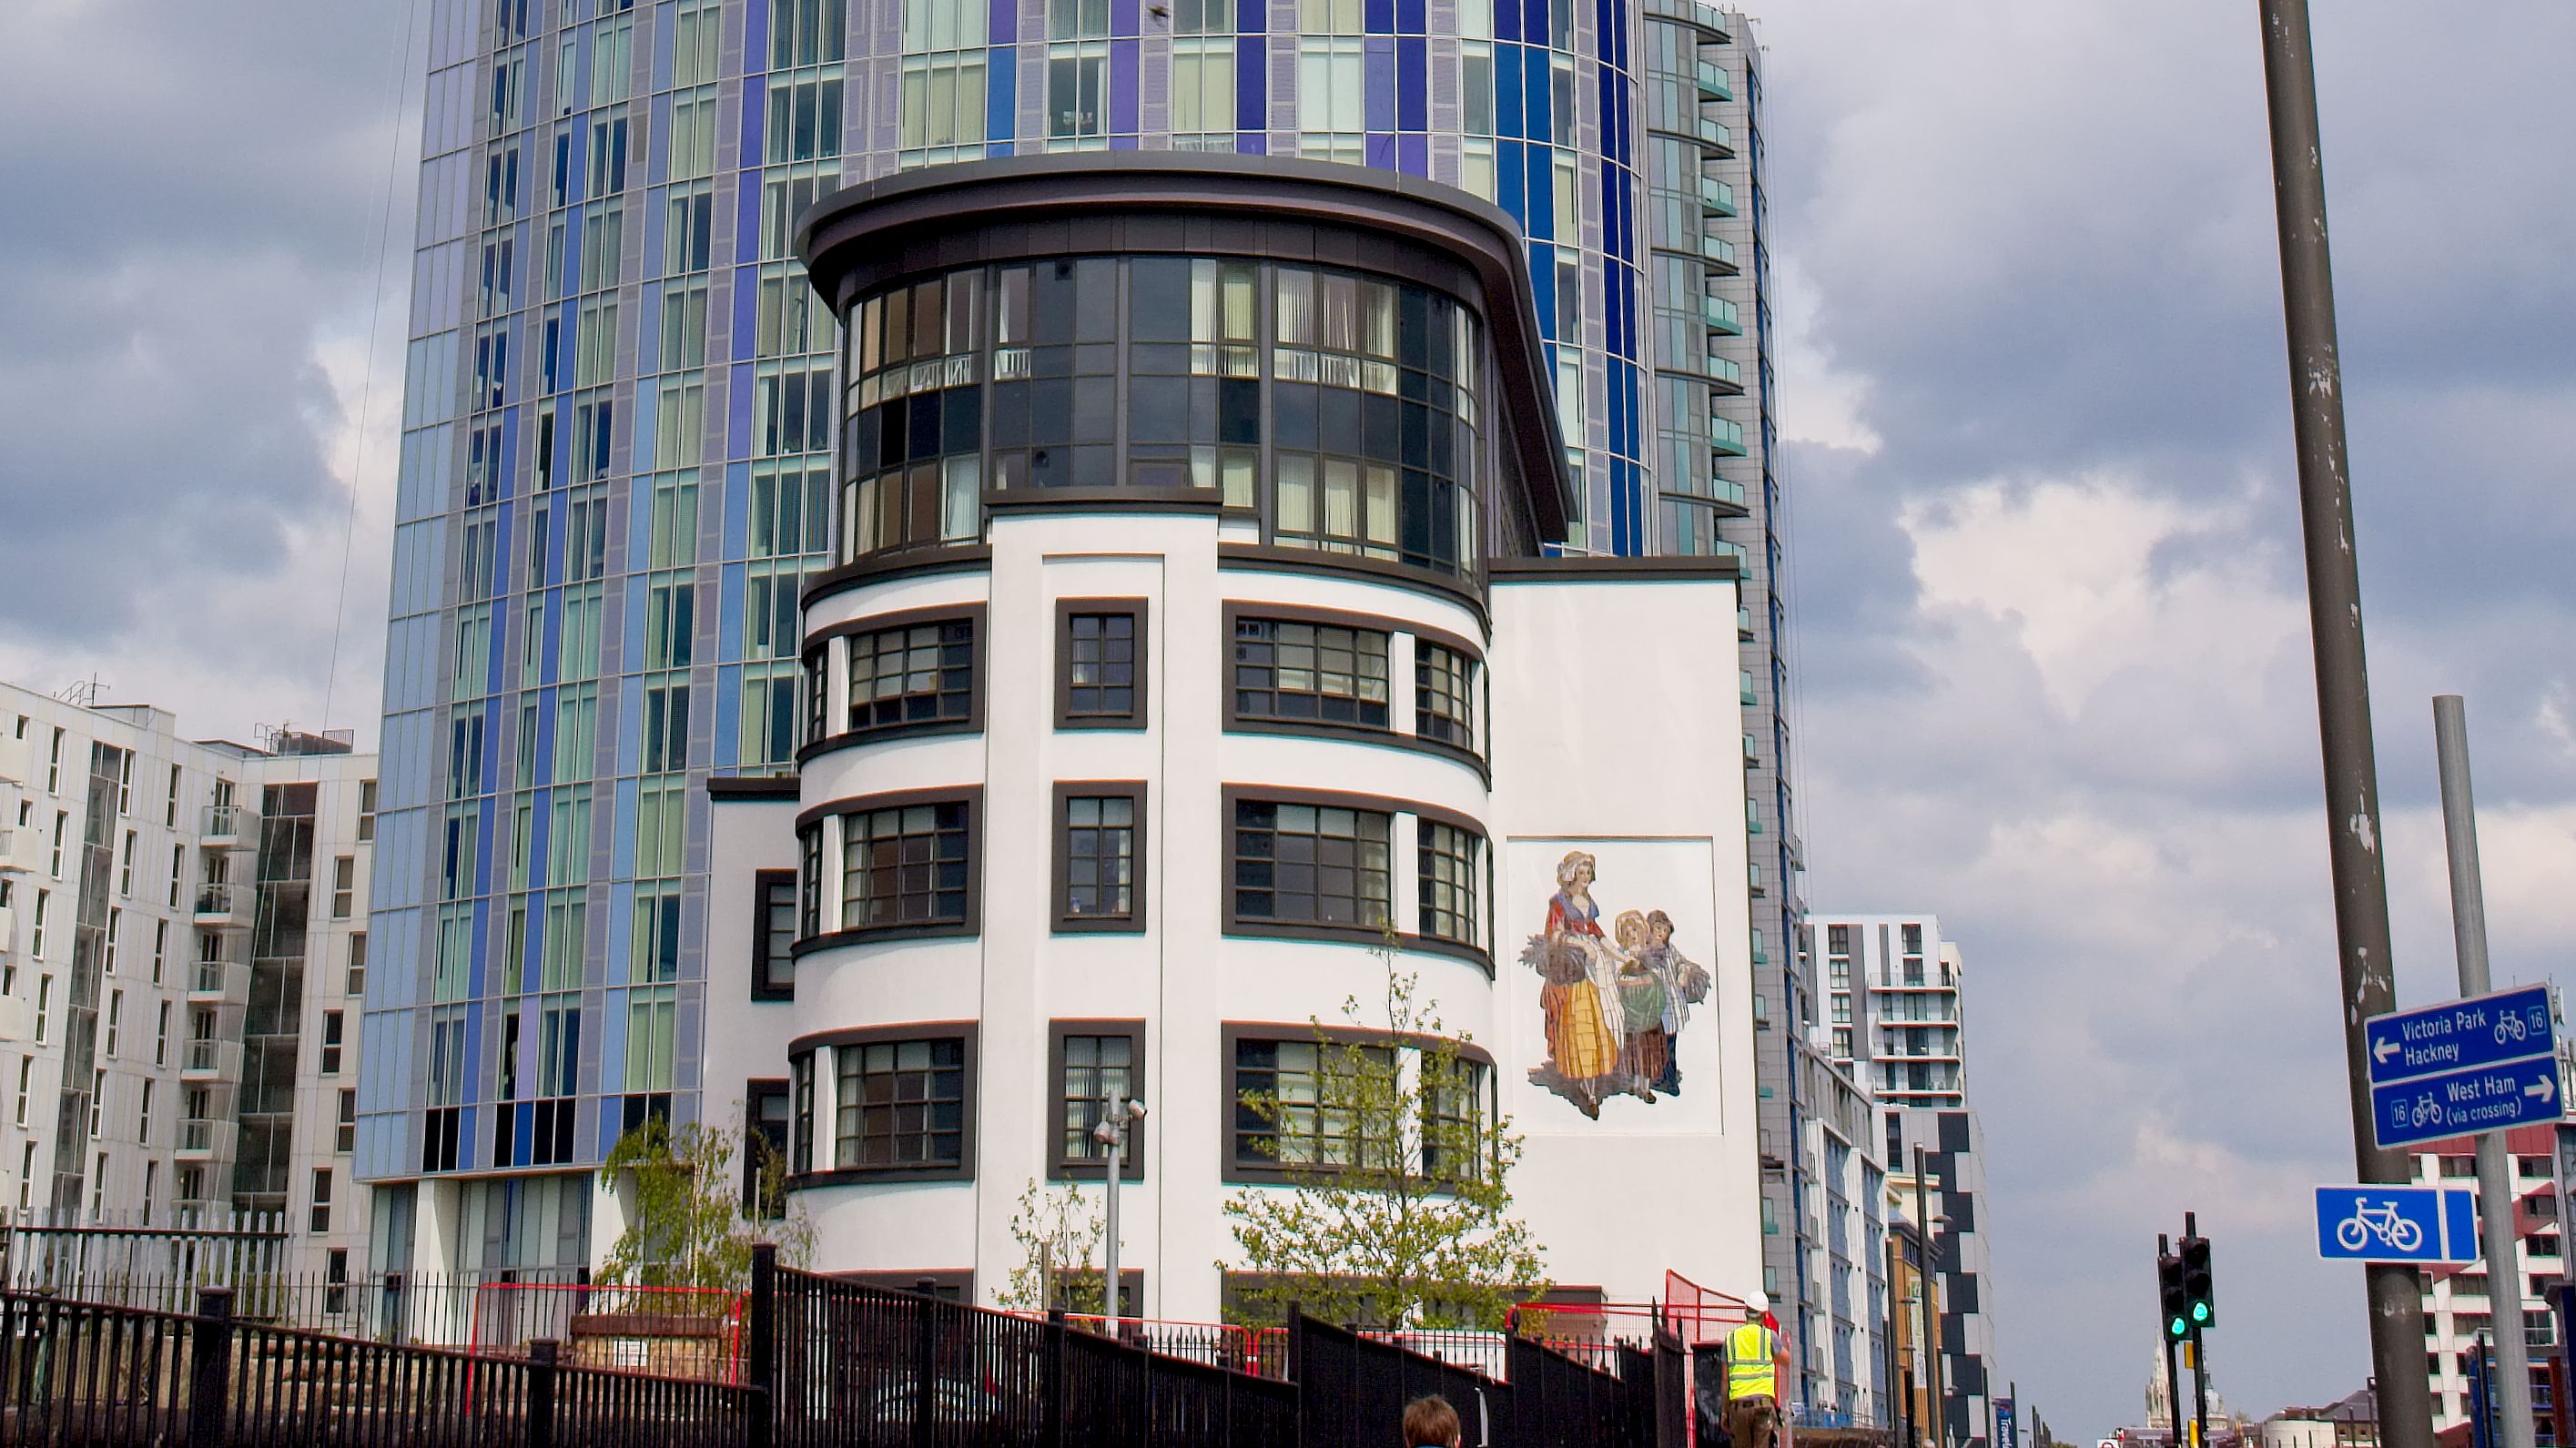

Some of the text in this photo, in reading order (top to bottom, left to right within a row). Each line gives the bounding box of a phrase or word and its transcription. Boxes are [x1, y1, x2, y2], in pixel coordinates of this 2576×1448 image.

[2402, 1008, 2487, 1041] Victoria Park
[2530, 1011, 2543, 1028] 16
[2405, 1043, 2459, 1067] Hackney
[2447, 1076, 2516, 1102] West Ham
[2394, 1105, 2406, 1121] 16
[2446, 1095, 2521, 1127] (via crossing)
